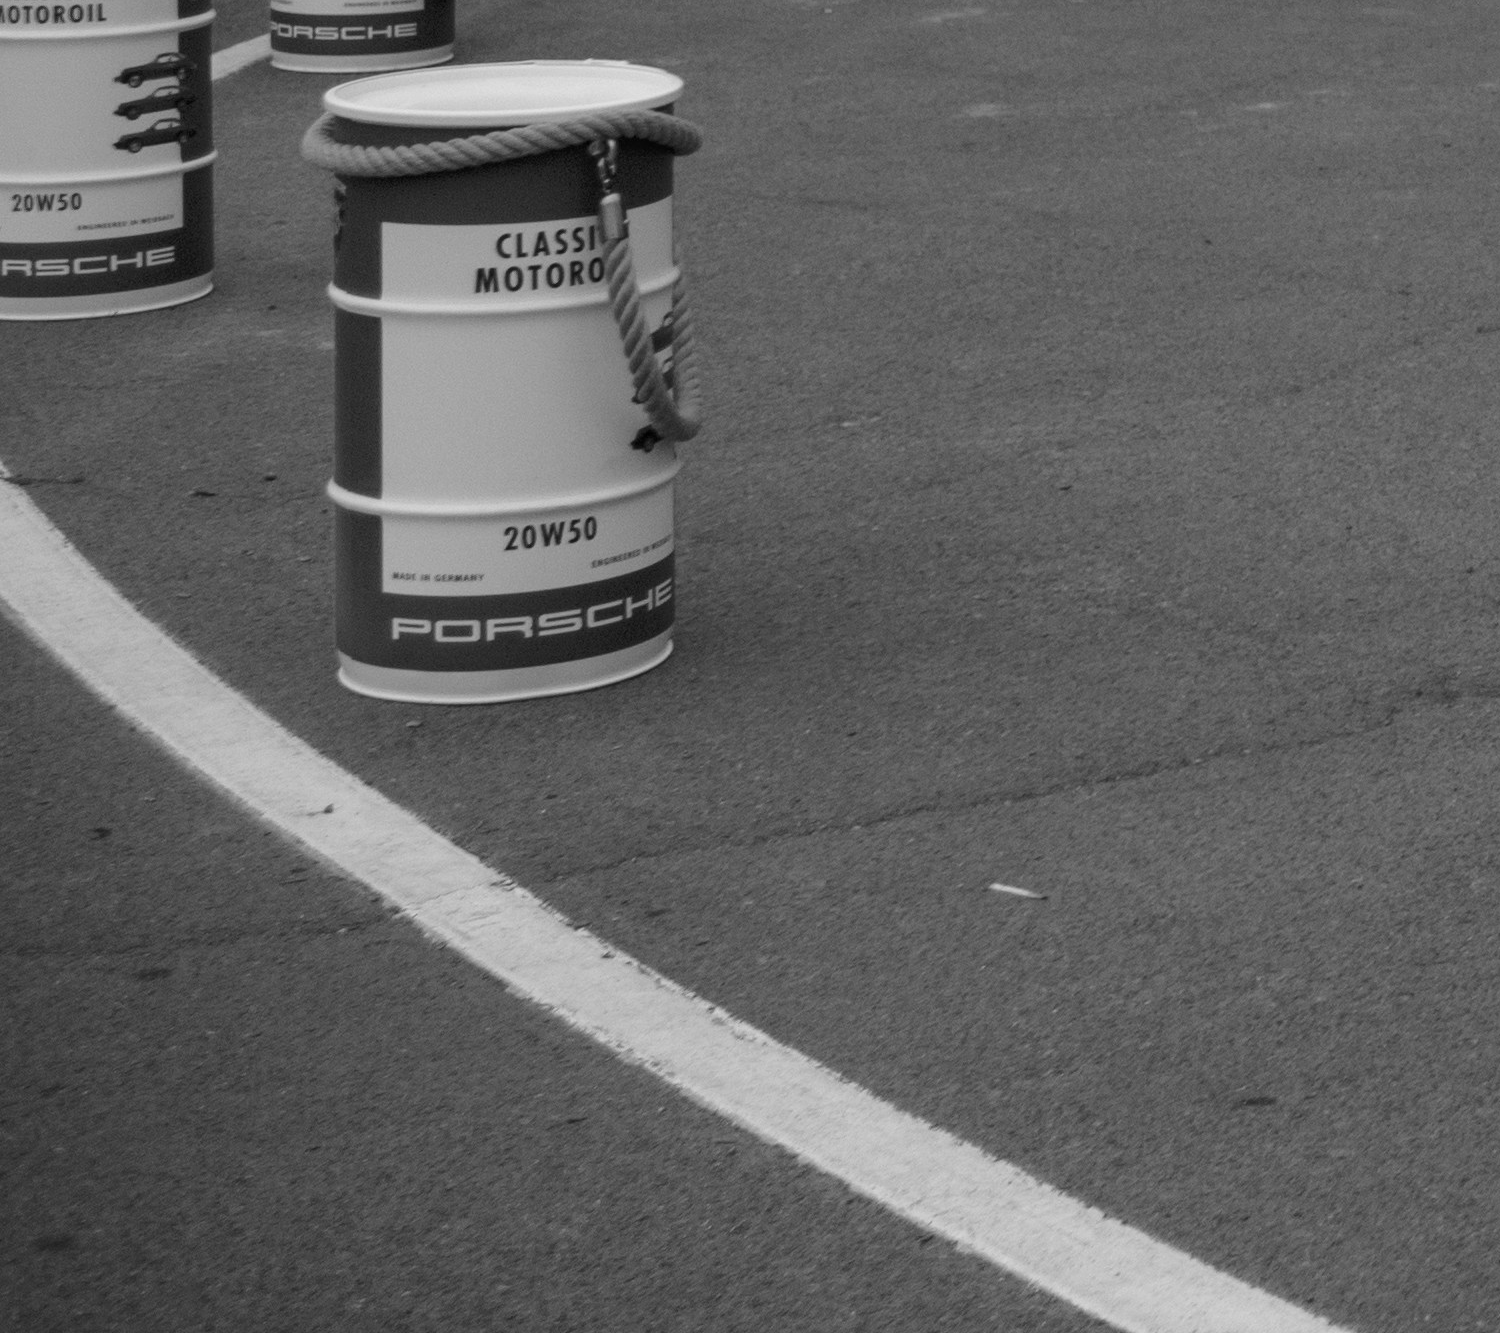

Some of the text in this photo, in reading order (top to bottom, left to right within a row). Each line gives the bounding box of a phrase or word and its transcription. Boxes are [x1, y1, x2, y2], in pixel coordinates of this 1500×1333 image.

[11, 192, 83, 213] 20W50
[496, 224, 596, 259] CLASSI
[1, 245, 176, 277] RSCHE
[475, 257, 605, 293] MOTORO
[504, 516, 598, 551] 20W50
[391, 578, 672, 643] PORSCHE
